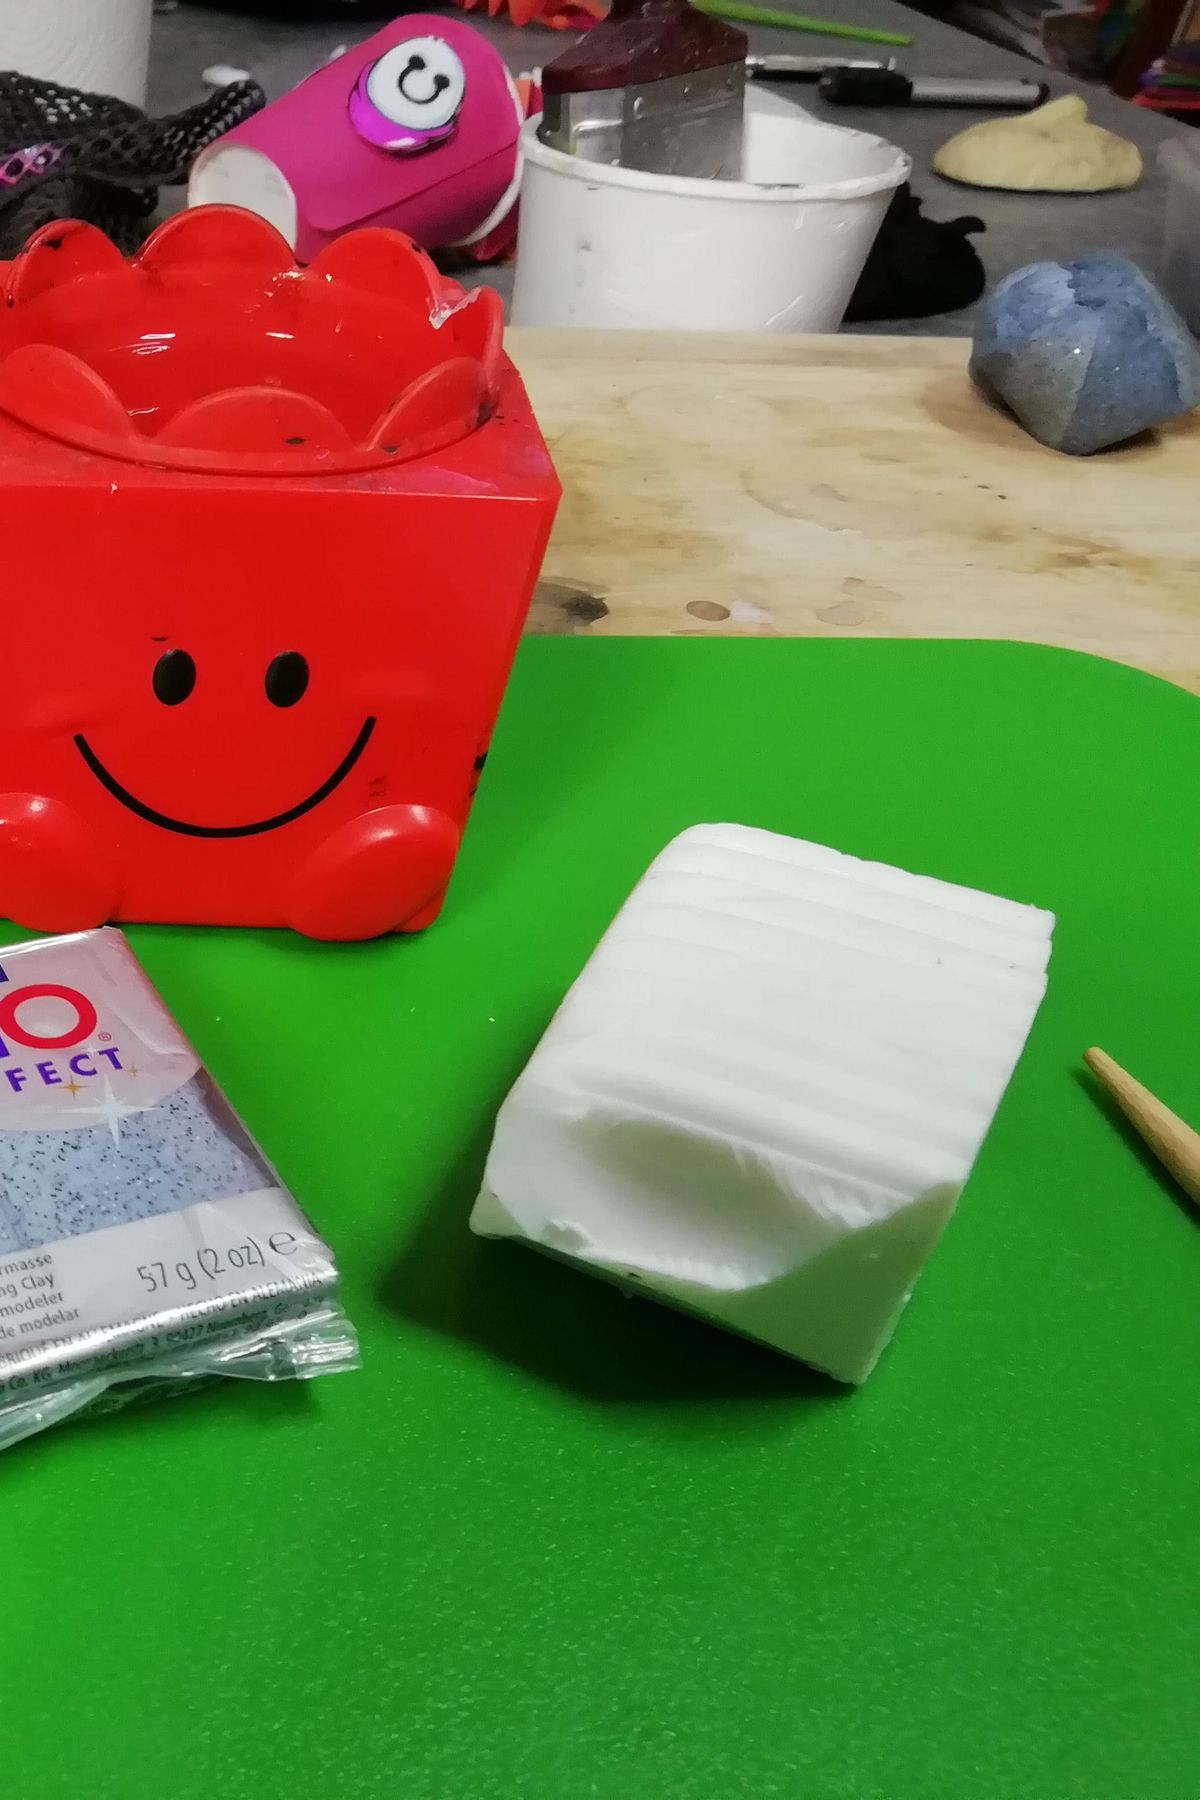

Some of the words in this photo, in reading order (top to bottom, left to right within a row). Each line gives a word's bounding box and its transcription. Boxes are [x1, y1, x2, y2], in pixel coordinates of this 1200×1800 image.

[136, 1261, 168, 1292] 57
[175, 1261, 197, 1291] g
[196, 1247, 227, 1281] (2
[227, 1234, 265, 1269] oz)
[20, 1273, 55, 1291] Clay
[18, 1307, 81, 1335] modelar
